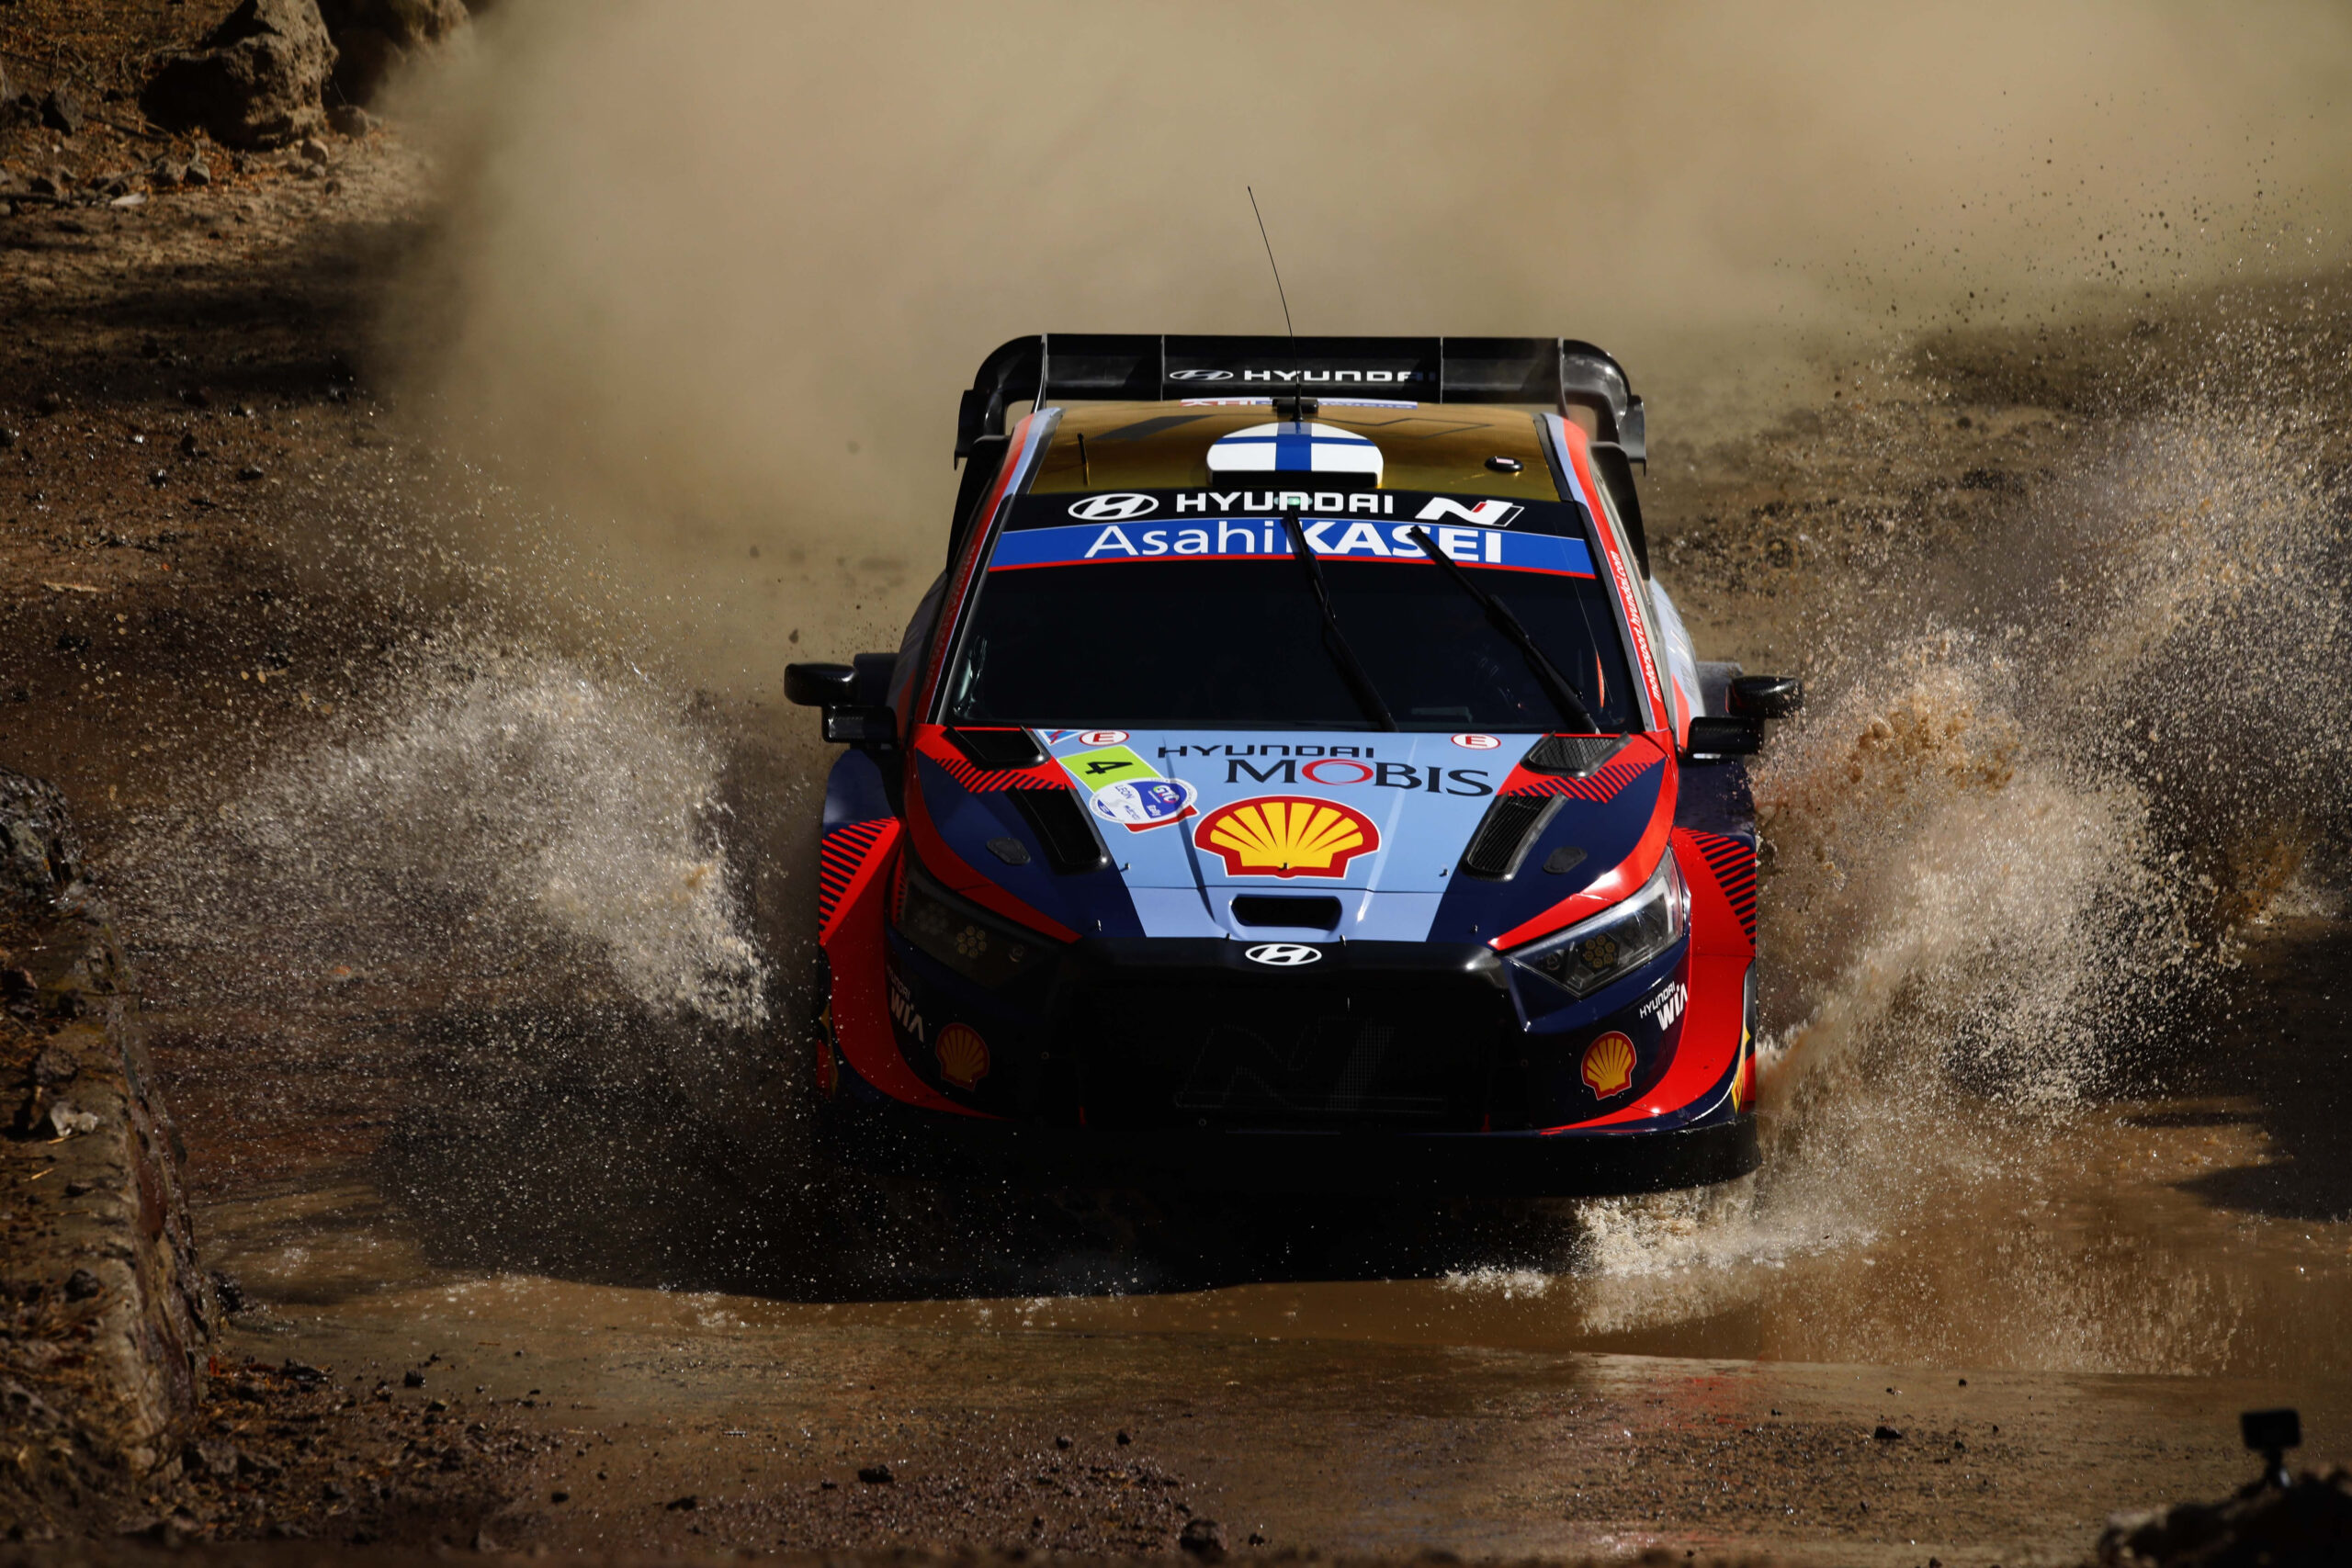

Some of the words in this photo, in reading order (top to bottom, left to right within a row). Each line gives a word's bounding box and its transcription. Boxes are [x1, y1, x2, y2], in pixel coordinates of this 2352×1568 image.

[1176, 491, 1394, 514] HYUNDAI
[1084, 520, 1274, 558] Asahi
[1286, 519, 1502, 564] KASEI
[1091, 731, 1115, 743] E
[1465, 736, 1487, 747] E
[1158, 744, 1374, 759] HYUNDAI
[1085, 761, 1134, 775] 4
[1224, 758, 1494, 797] MOBIS
[1639, 981, 1677, 1020] HYUNDAI
